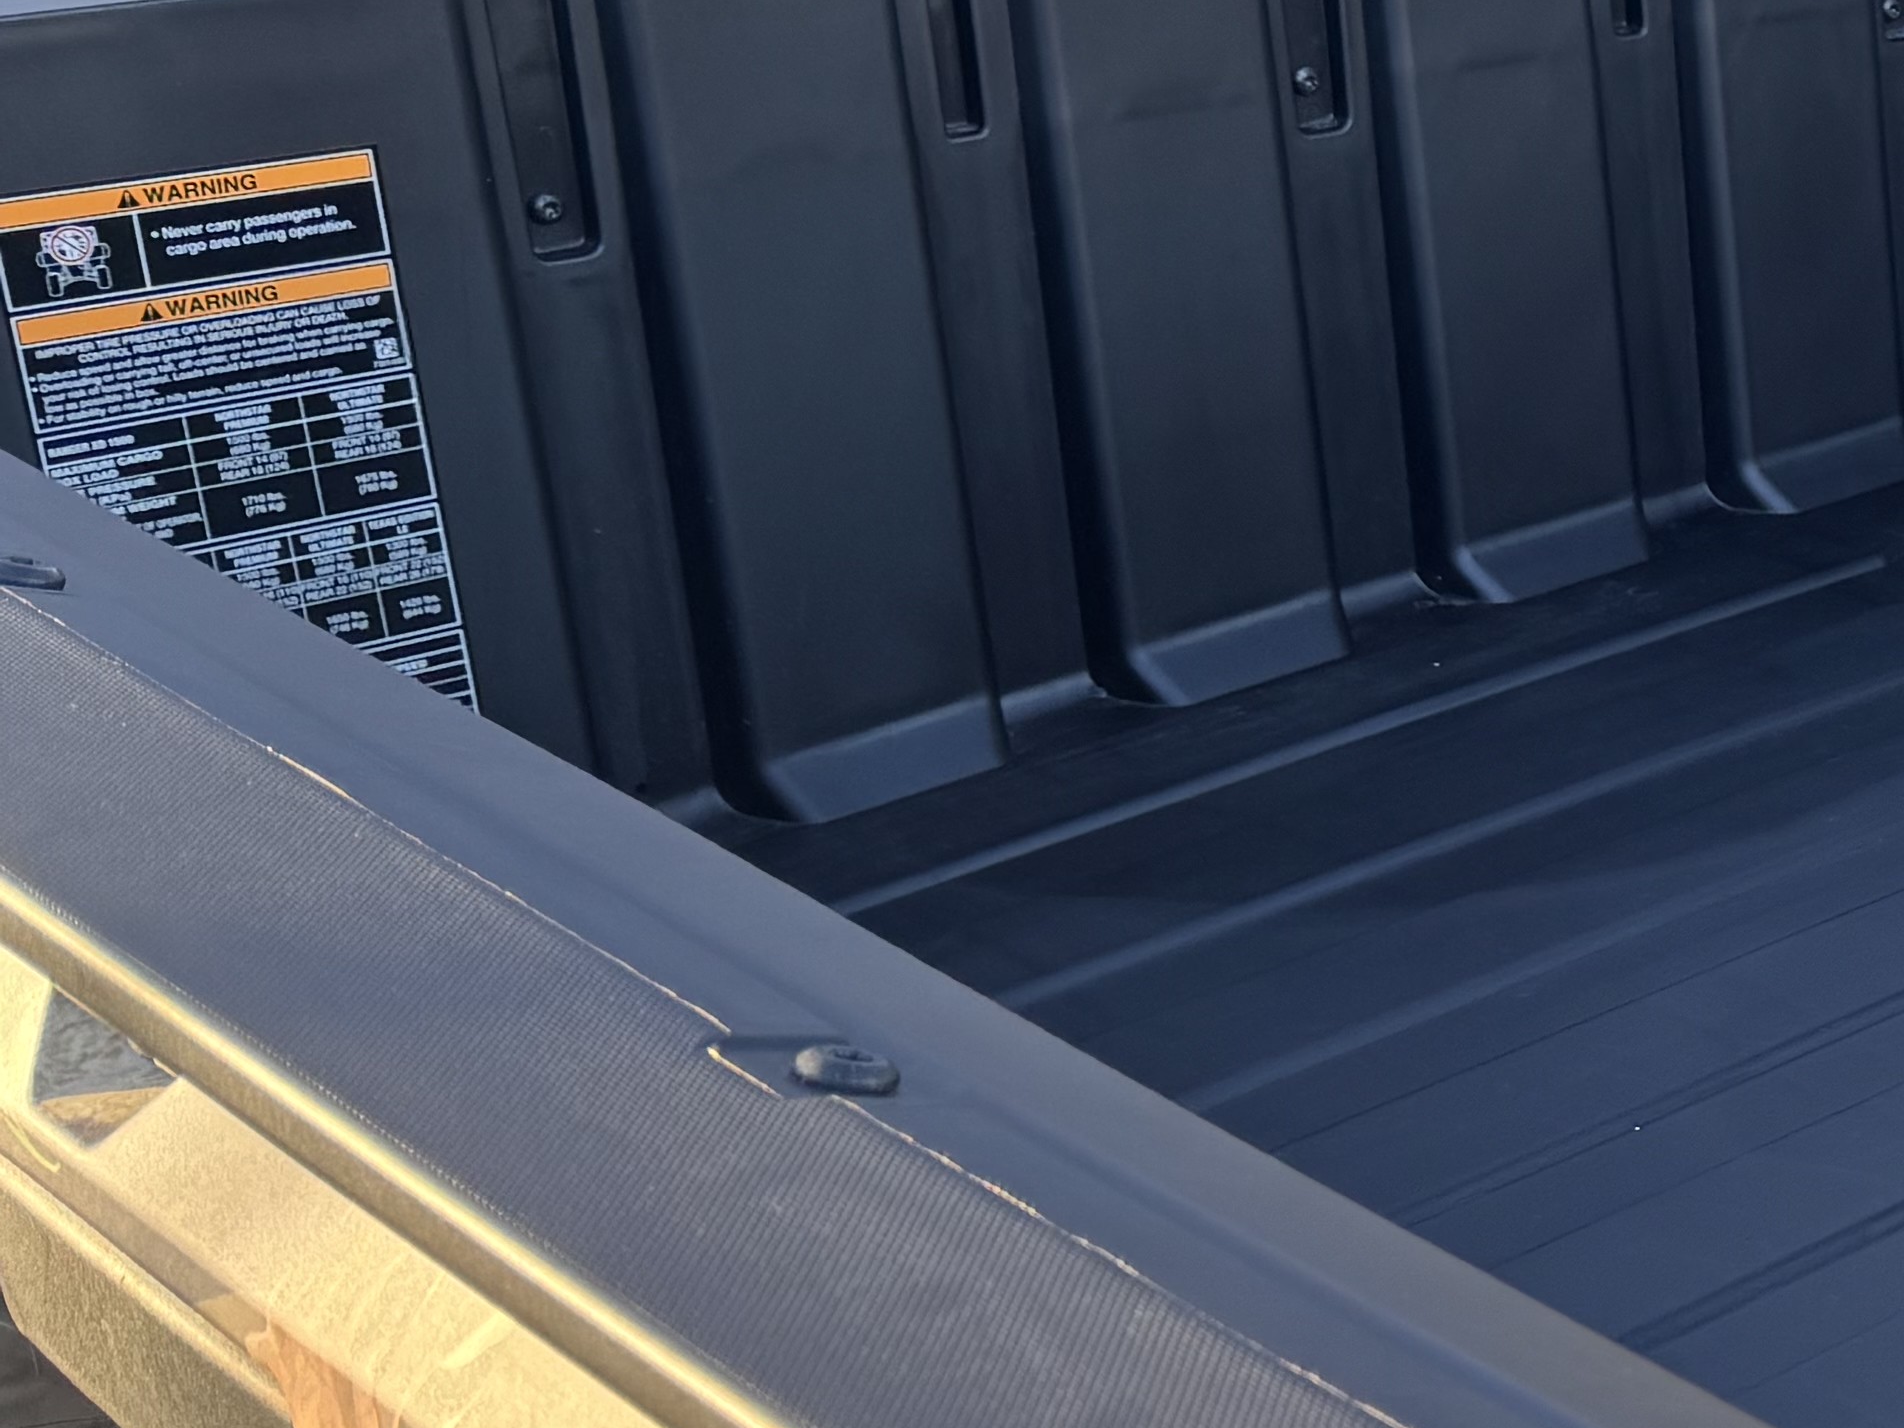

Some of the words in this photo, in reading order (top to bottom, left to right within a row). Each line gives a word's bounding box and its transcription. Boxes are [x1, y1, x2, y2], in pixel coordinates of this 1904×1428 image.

[143, 175, 257, 203] WARNING
[161, 225, 204, 240] Never
[205, 220, 242, 233] carry
[244, 208, 322, 230] passengers
[324, 205, 338, 216] in
[166, 242, 208, 256] cargo
[209, 237, 241, 250] area
[242, 230, 288, 245] during
[288, 220, 357, 239] operation.
[165, 286, 278, 316] WARNING
[117, 451, 163, 467] CARGO
[126, 495, 177, 513] WEIGHT
